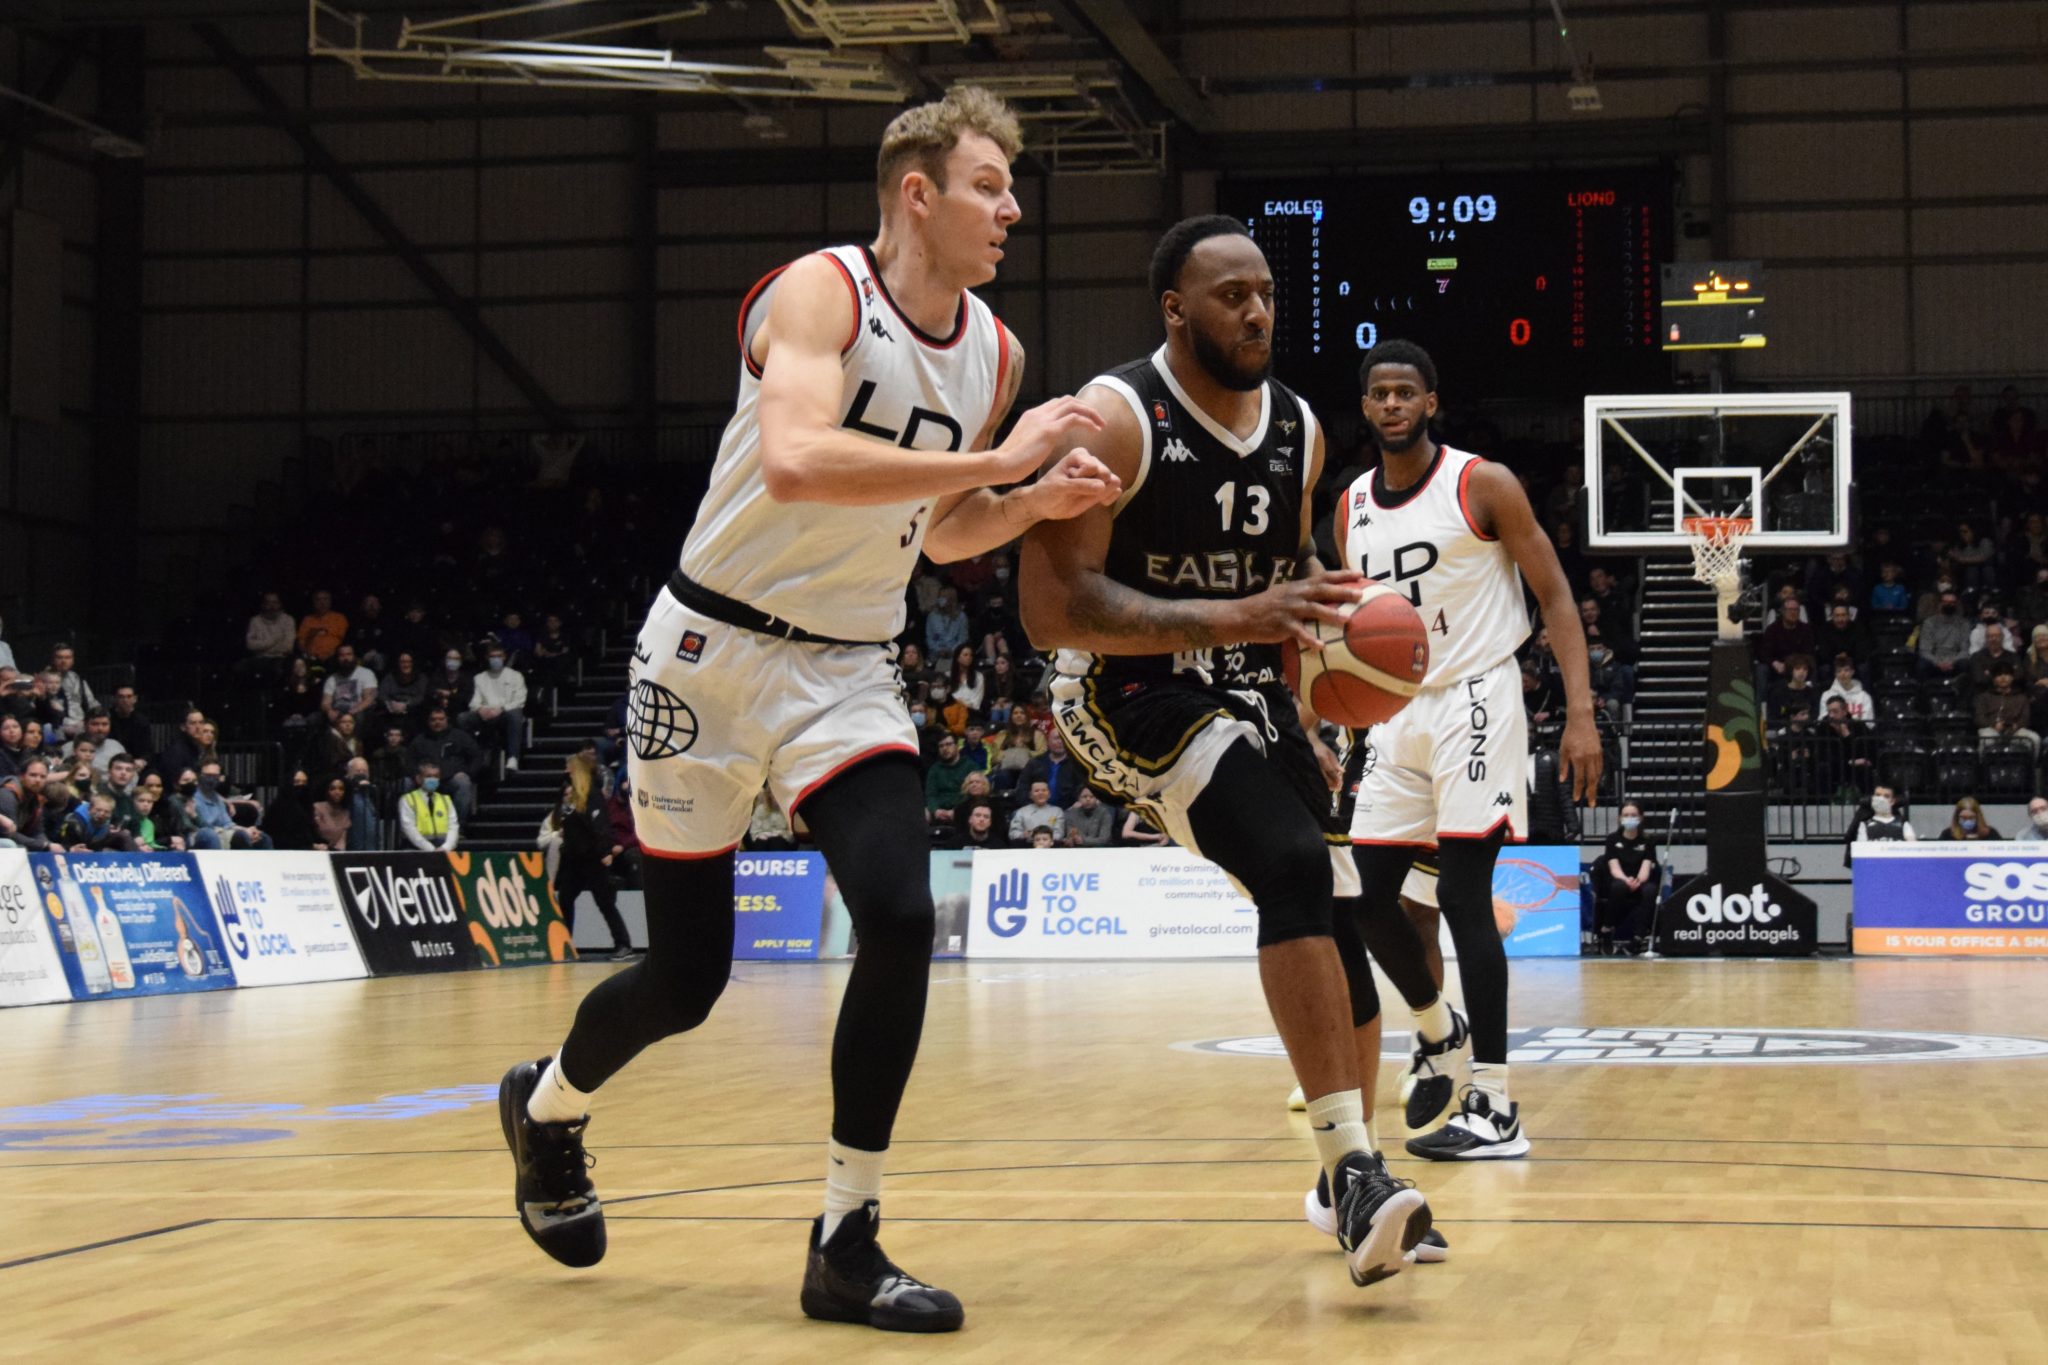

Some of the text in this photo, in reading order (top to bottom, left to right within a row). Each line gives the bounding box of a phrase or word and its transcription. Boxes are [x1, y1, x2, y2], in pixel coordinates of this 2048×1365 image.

[1408, 194, 1498, 224] 9:09
[1355, 322, 1378, 349] 0
[1509, 318, 1532, 346] 0
[1214, 481, 1271, 536] 13
[1431, 607, 1449, 636] 4
[1468, 677, 1489, 783] LIONS
[72, 861, 145, 887] Distinctively
[1150, 863, 1220, 875] We're aiming
[237, 881, 267, 903] GIVE
[1041, 873, 1100, 892] GIVE
[1159, 877, 1195, 886] million
[370, 865, 458, 926] Vertu
[476, 858, 541, 929] dot.
[734, 895, 782, 912] ESS.
[1042, 895, 1078, 913] TO
[1165, 889, 1225, 901] community
[1686, 882, 1782, 923] dot.
[243, 908, 264, 930] TO
[1966, 904, 2048, 923] GROU
[1042, 916, 1128, 936] LOCAL
[1149, 923, 1254, 938] givetolocal.com
[1674, 924, 1800, 945] real good bagels
[252, 933, 297, 956] LOCAL
[411, 940, 455, 958] Motors
[753, 939, 813, 948] APPLY NOW
[1885, 935, 1900, 947] IS
[1903, 935, 1947, 947] YOUR
[1950, 935, 2004, 948] OFFICE
[2009, 935, 2021, 947] A
